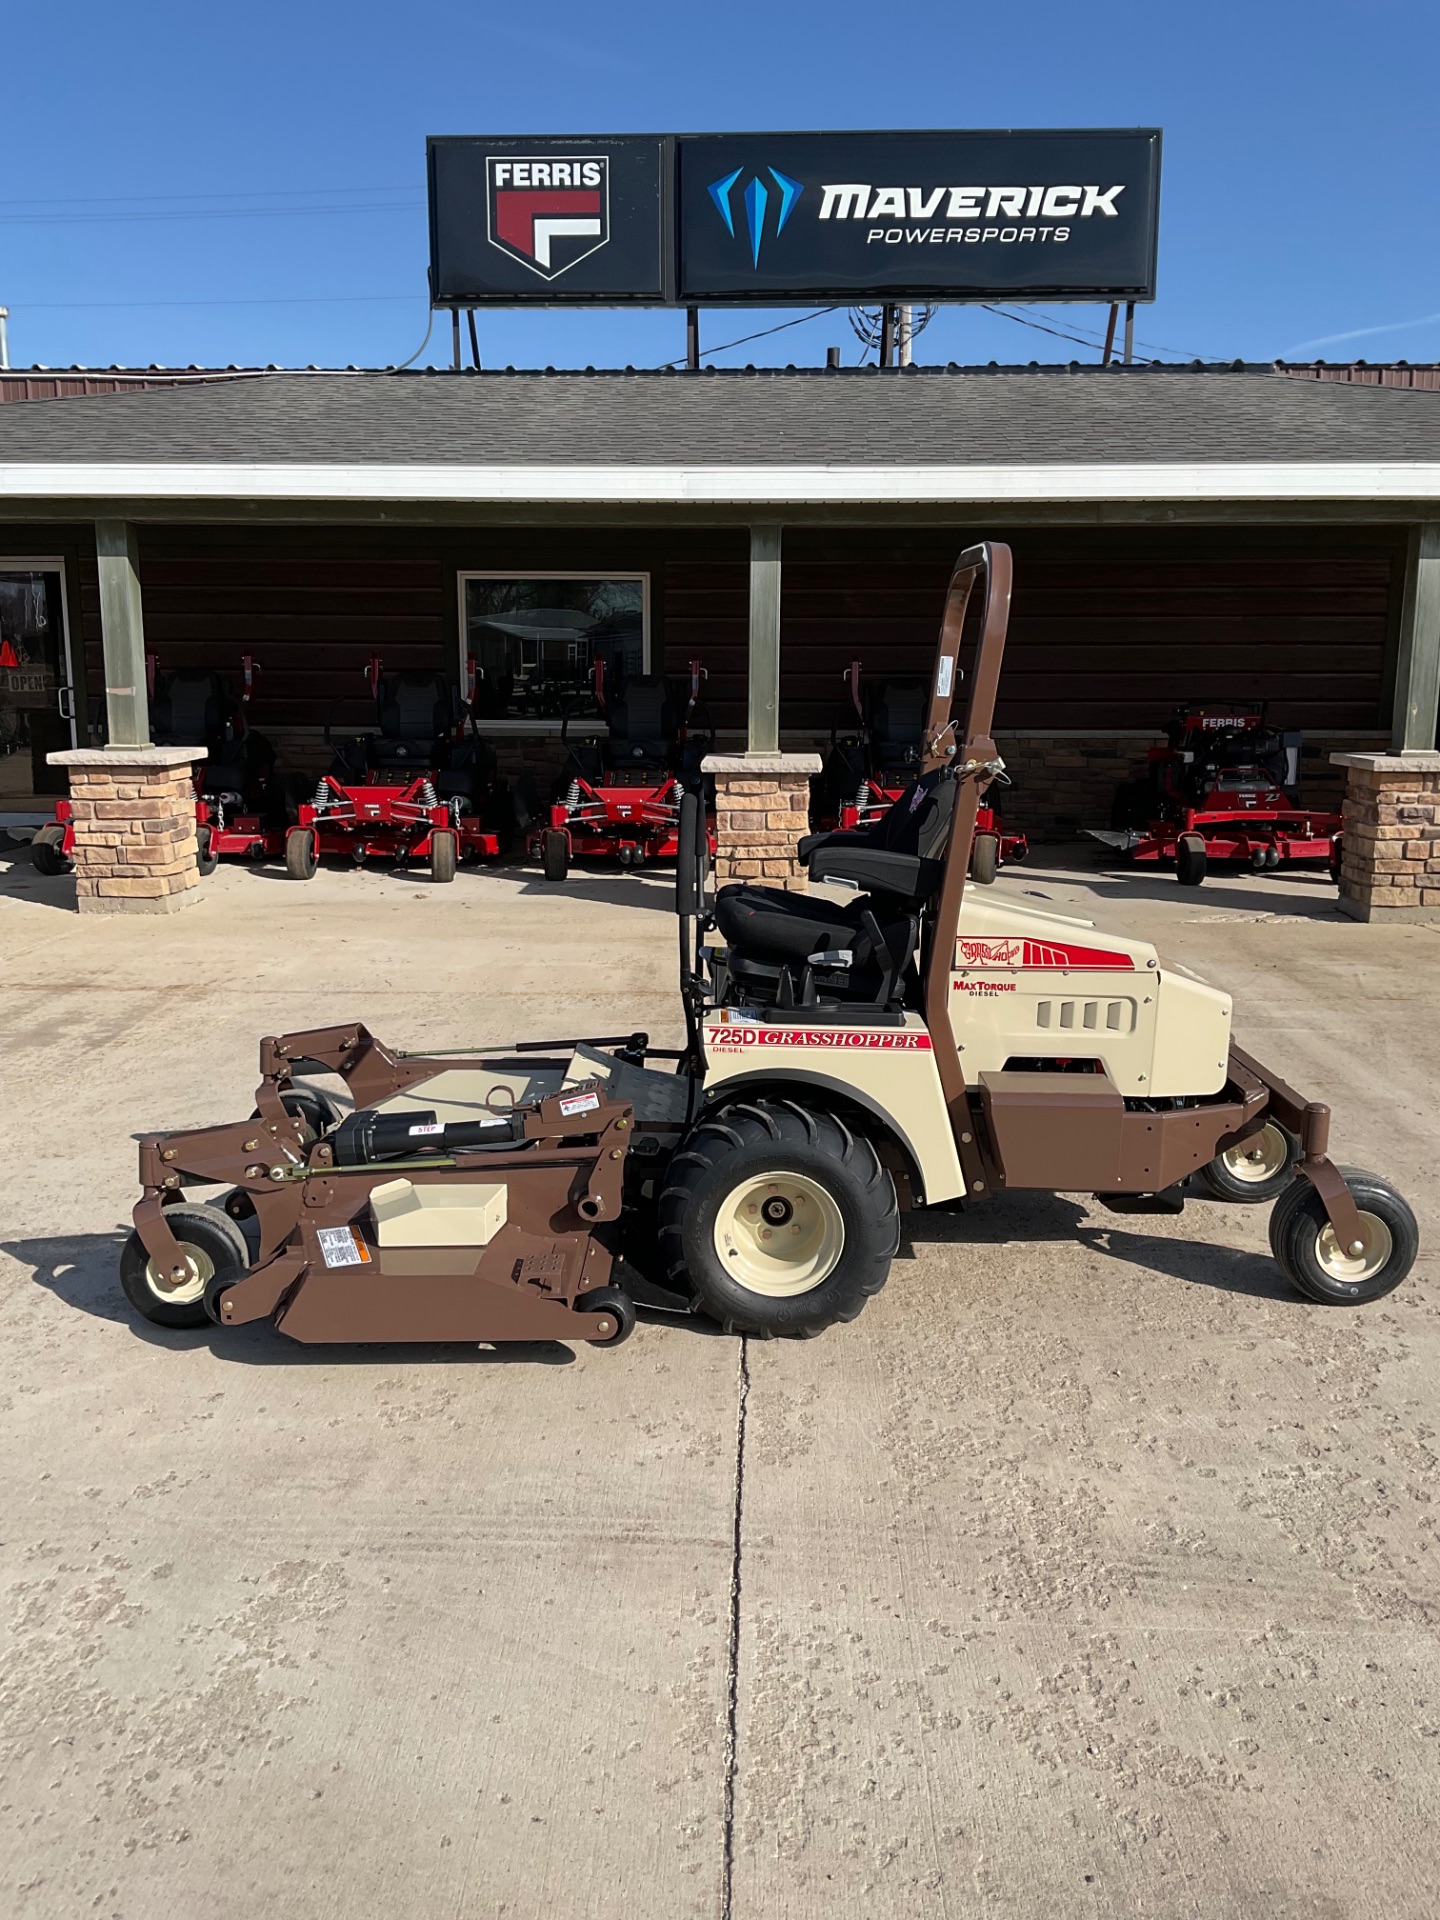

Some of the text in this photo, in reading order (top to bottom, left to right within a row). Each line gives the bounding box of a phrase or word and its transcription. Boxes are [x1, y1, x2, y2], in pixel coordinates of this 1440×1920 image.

[495, 162, 601, 187] FERRIS
[818, 184, 1126, 219] MAVERICK
[866, 227, 1071, 244] POWERSPORTS
[11, 676, 43, 691] OPEN
[1202, 718, 1246, 728] FERRIS
[708, 1028, 919, 1048] 725D GRASSHOPPER
[712, 1046, 746, 1054] DIESEL
